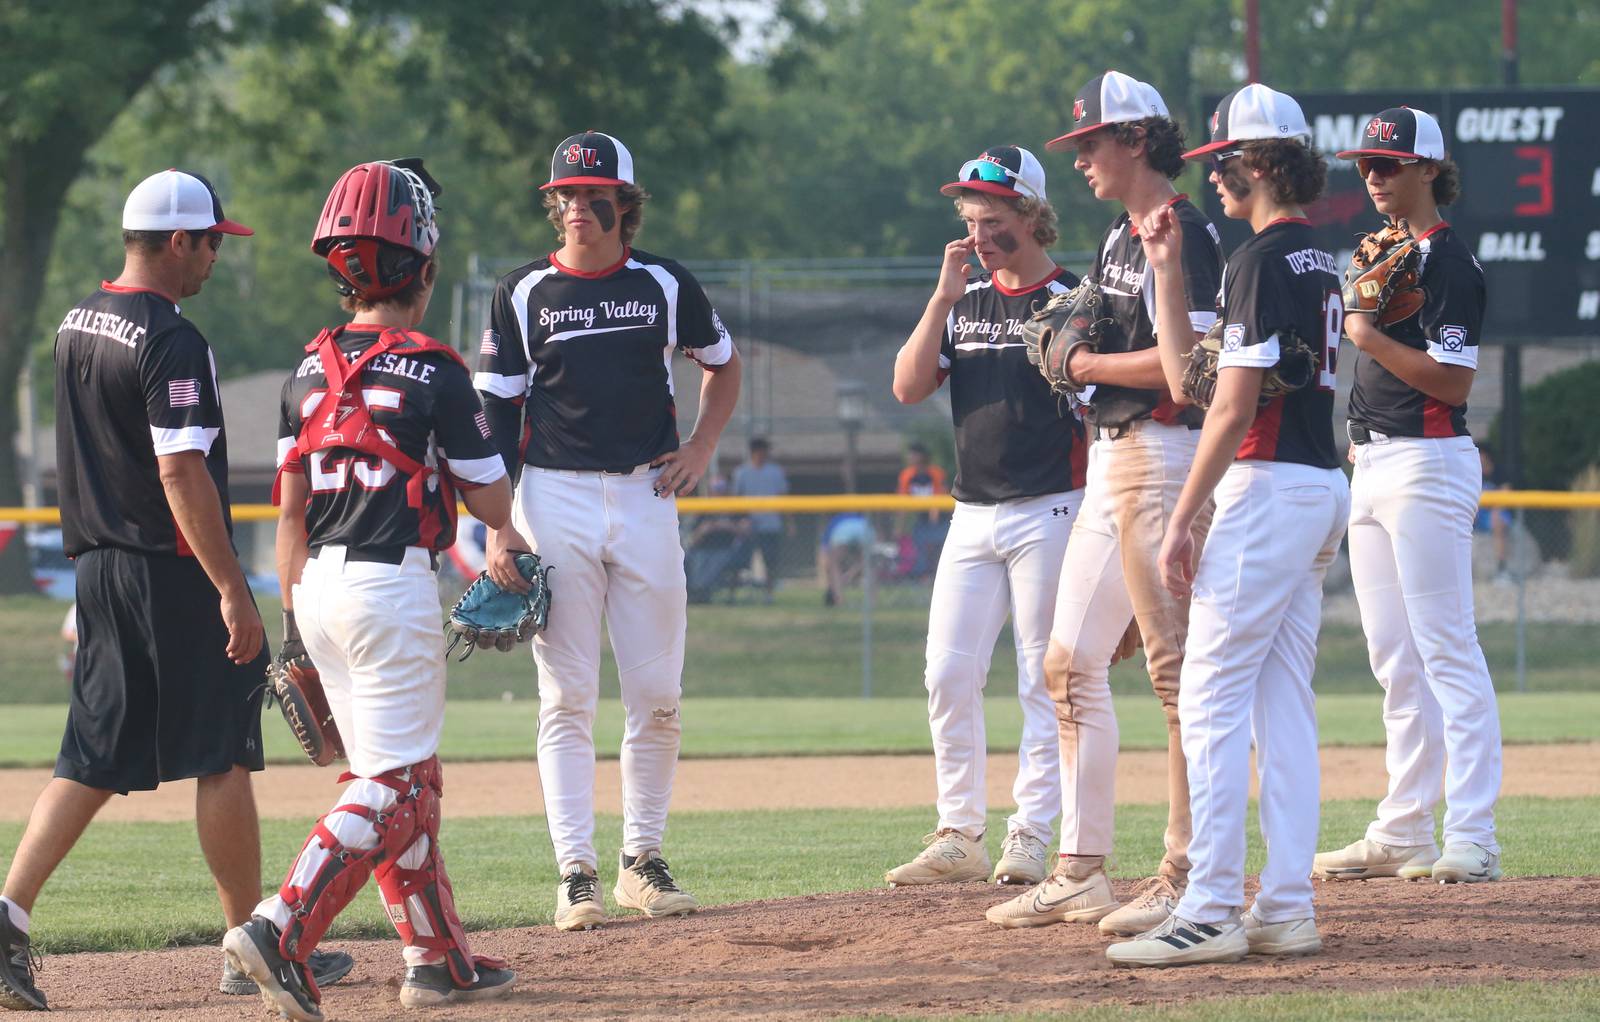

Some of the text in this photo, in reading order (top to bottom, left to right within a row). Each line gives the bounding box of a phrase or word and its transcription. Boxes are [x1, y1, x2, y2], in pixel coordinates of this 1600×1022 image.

[1366, 117, 1396, 143] SV
[1456, 107, 1564, 141] GUEST
[566, 144, 597, 168] SV
[1515, 147, 1553, 215] 3
[1478, 232, 1546, 261] BALL
[539, 300, 659, 333] Spring Valley
[954, 316, 1002, 342] Spring
